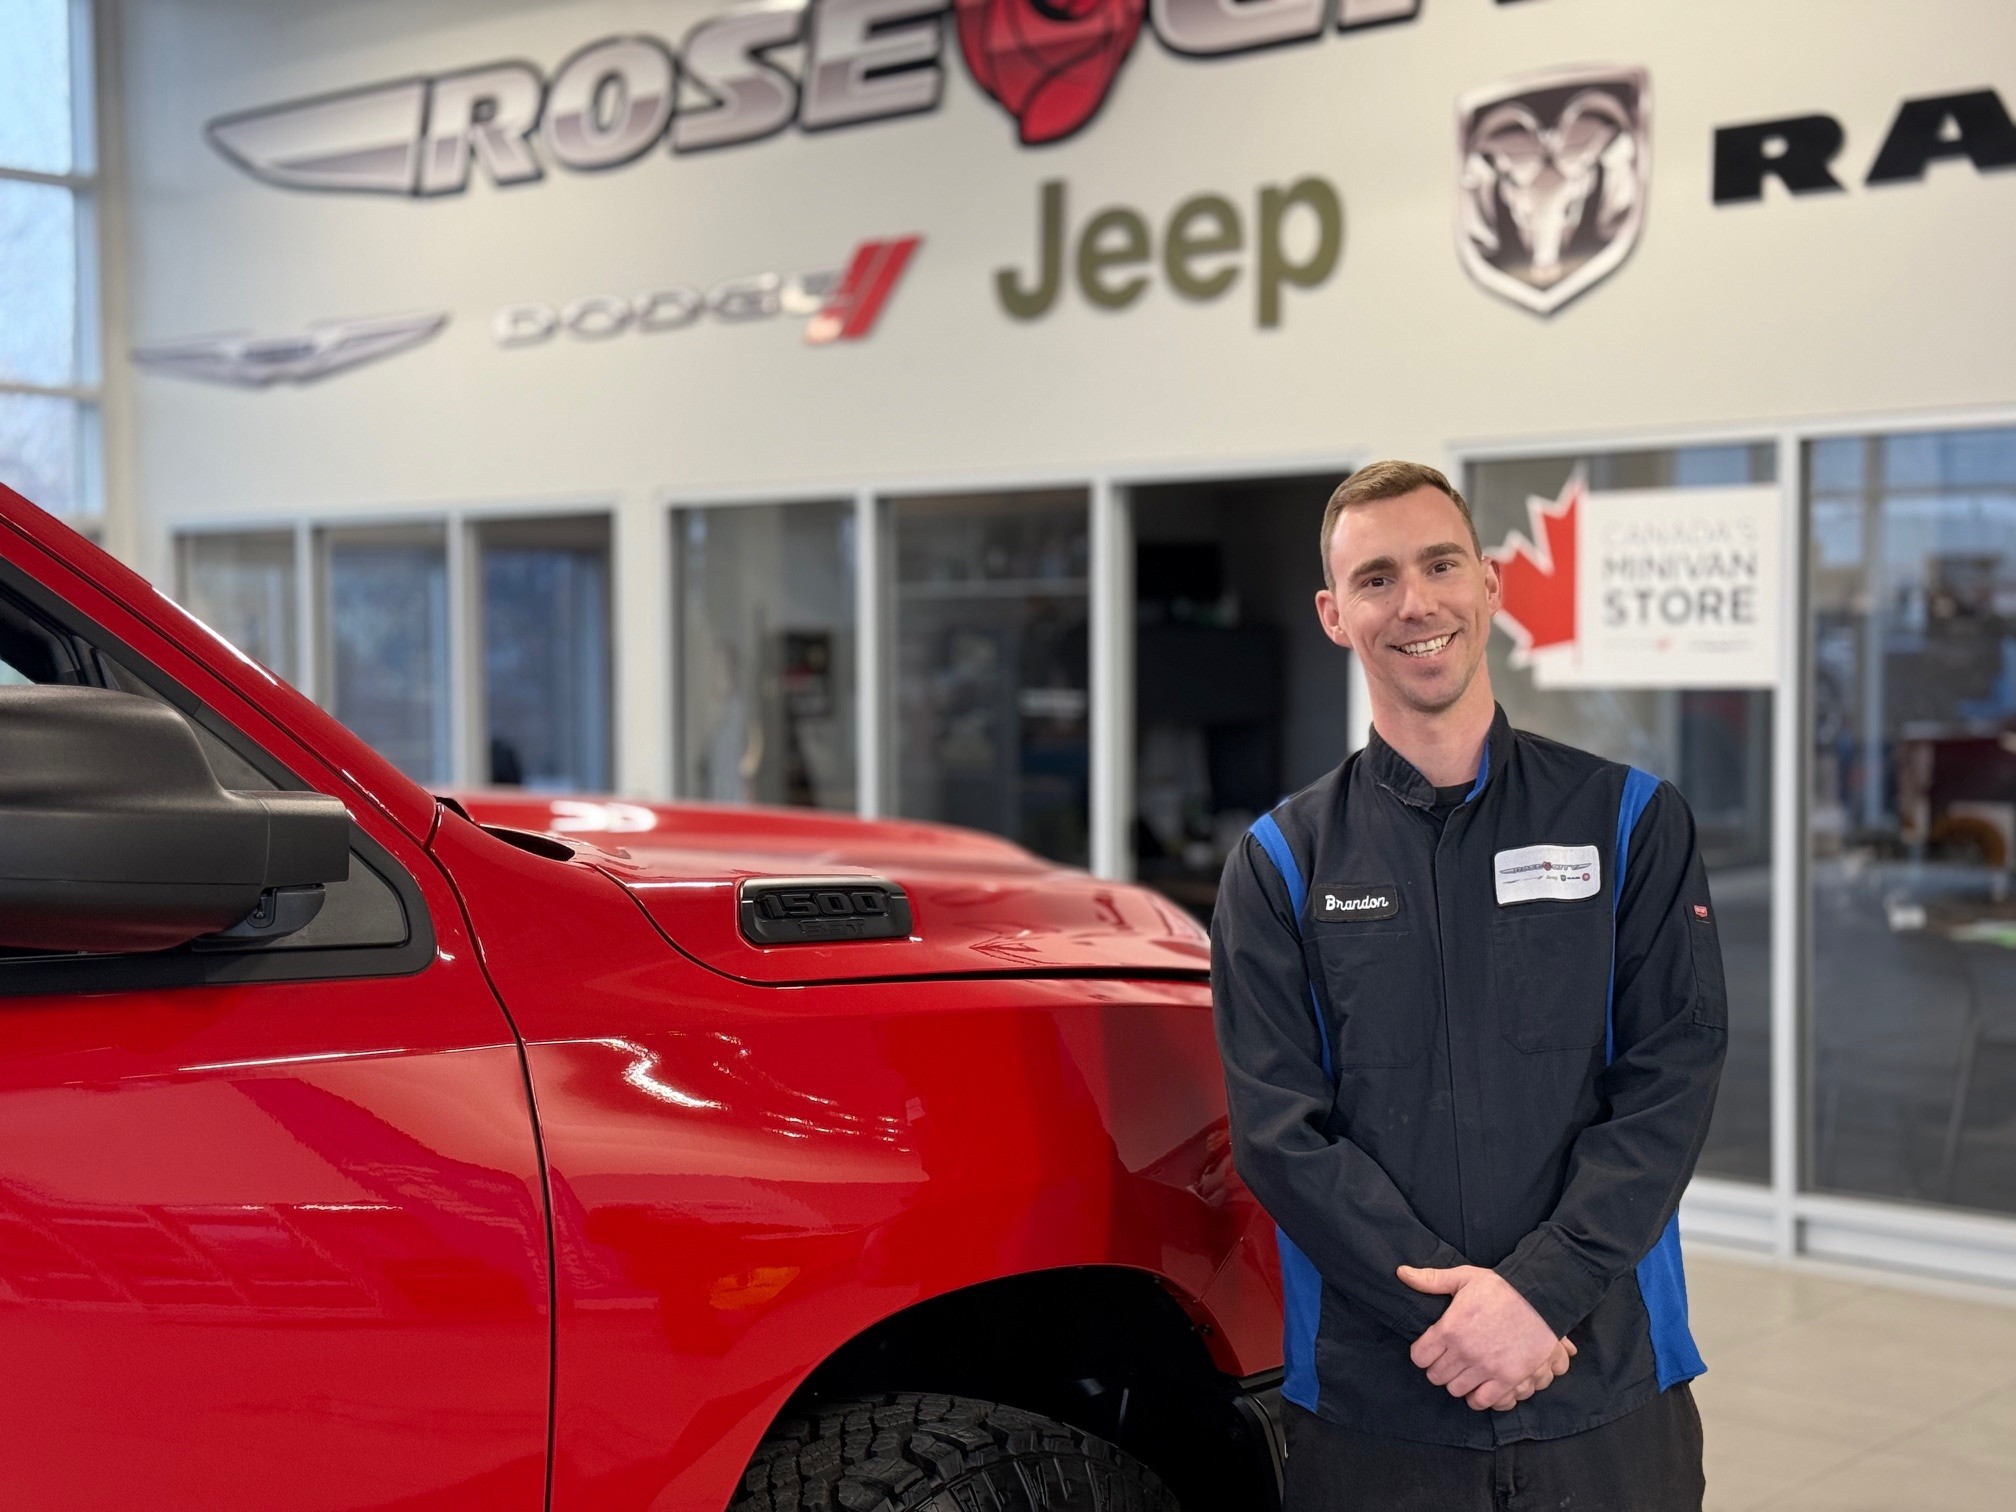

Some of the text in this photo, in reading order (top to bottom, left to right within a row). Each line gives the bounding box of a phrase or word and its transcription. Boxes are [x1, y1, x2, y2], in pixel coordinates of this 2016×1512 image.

[421, 0, 943, 197] ROSE
[991, 175, 1345, 330] Jeep
[1602, 550, 1758, 580] MINIVAN
[1603, 586, 1757, 627] STORE
[760, 891, 888, 919] 1500
[1325, 894, 1389, 911] Brandon
